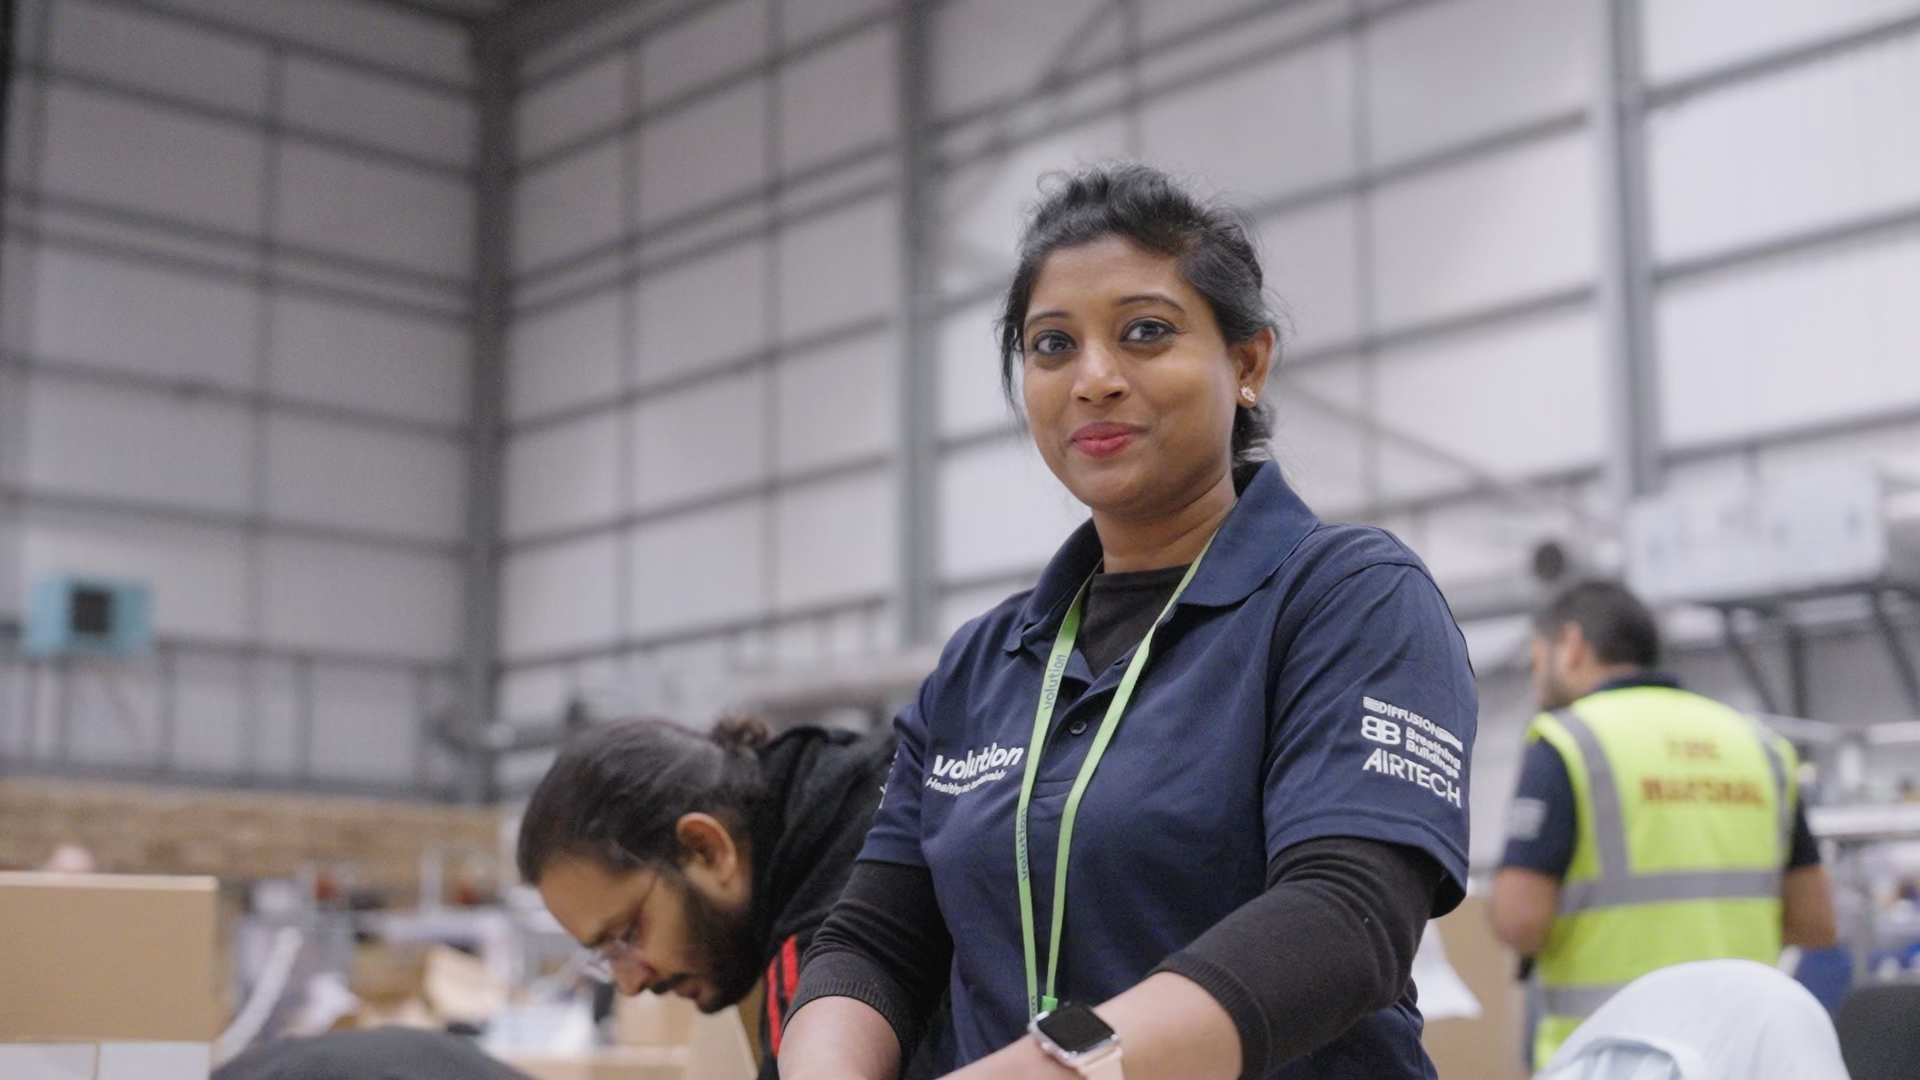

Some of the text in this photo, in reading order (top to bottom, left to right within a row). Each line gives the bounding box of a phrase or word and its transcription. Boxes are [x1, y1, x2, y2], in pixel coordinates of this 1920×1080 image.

[1044, 653, 1067, 711] volution
[1379, 701, 1441, 739] DIFFUSION
[932, 742, 1024, 780] volution
[1405, 739, 1459, 779] Buildings
[1406, 726, 1461, 770] Breathing
[925, 776, 962, 796] Healthy
[1362, 748, 1462, 808] AIRTECH
[1017, 807, 1029, 882] volution
